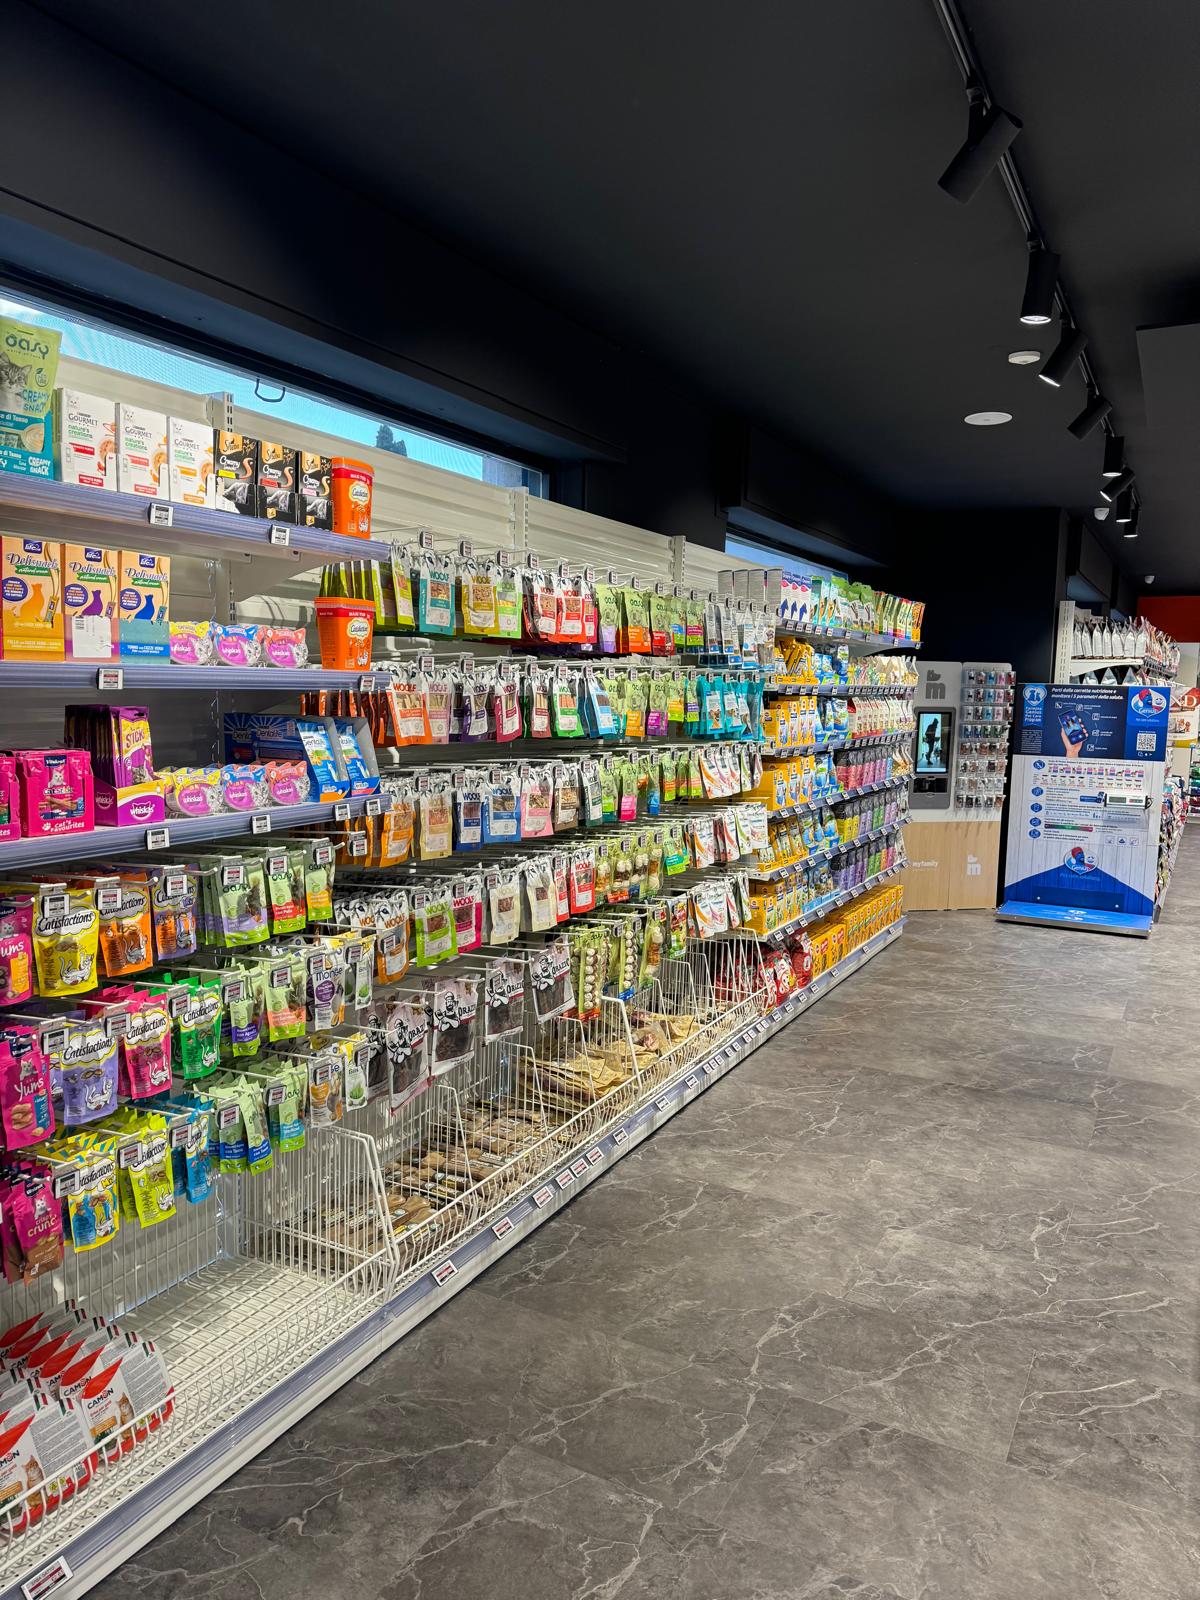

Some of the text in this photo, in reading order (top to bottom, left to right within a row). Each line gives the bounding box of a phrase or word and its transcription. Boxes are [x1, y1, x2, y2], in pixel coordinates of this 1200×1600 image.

[68, 413, 98, 426] GOURMET
[125, 426, 152, 439] GOURMET
[174, 438, 200, 450] GOURMET
[38, 912, 93, 932] Catisfactions
[1, 942, 24, 957] ums
[182, 1001, 219, 1023] Catisfactions
[127, 1017, 167, 1039] Catisfactions
[63, 1037, 113, 1061] Catisfactions
[87, 1388, 114, 1409] CAMON
[0, 1450, 19, 1467] MON
